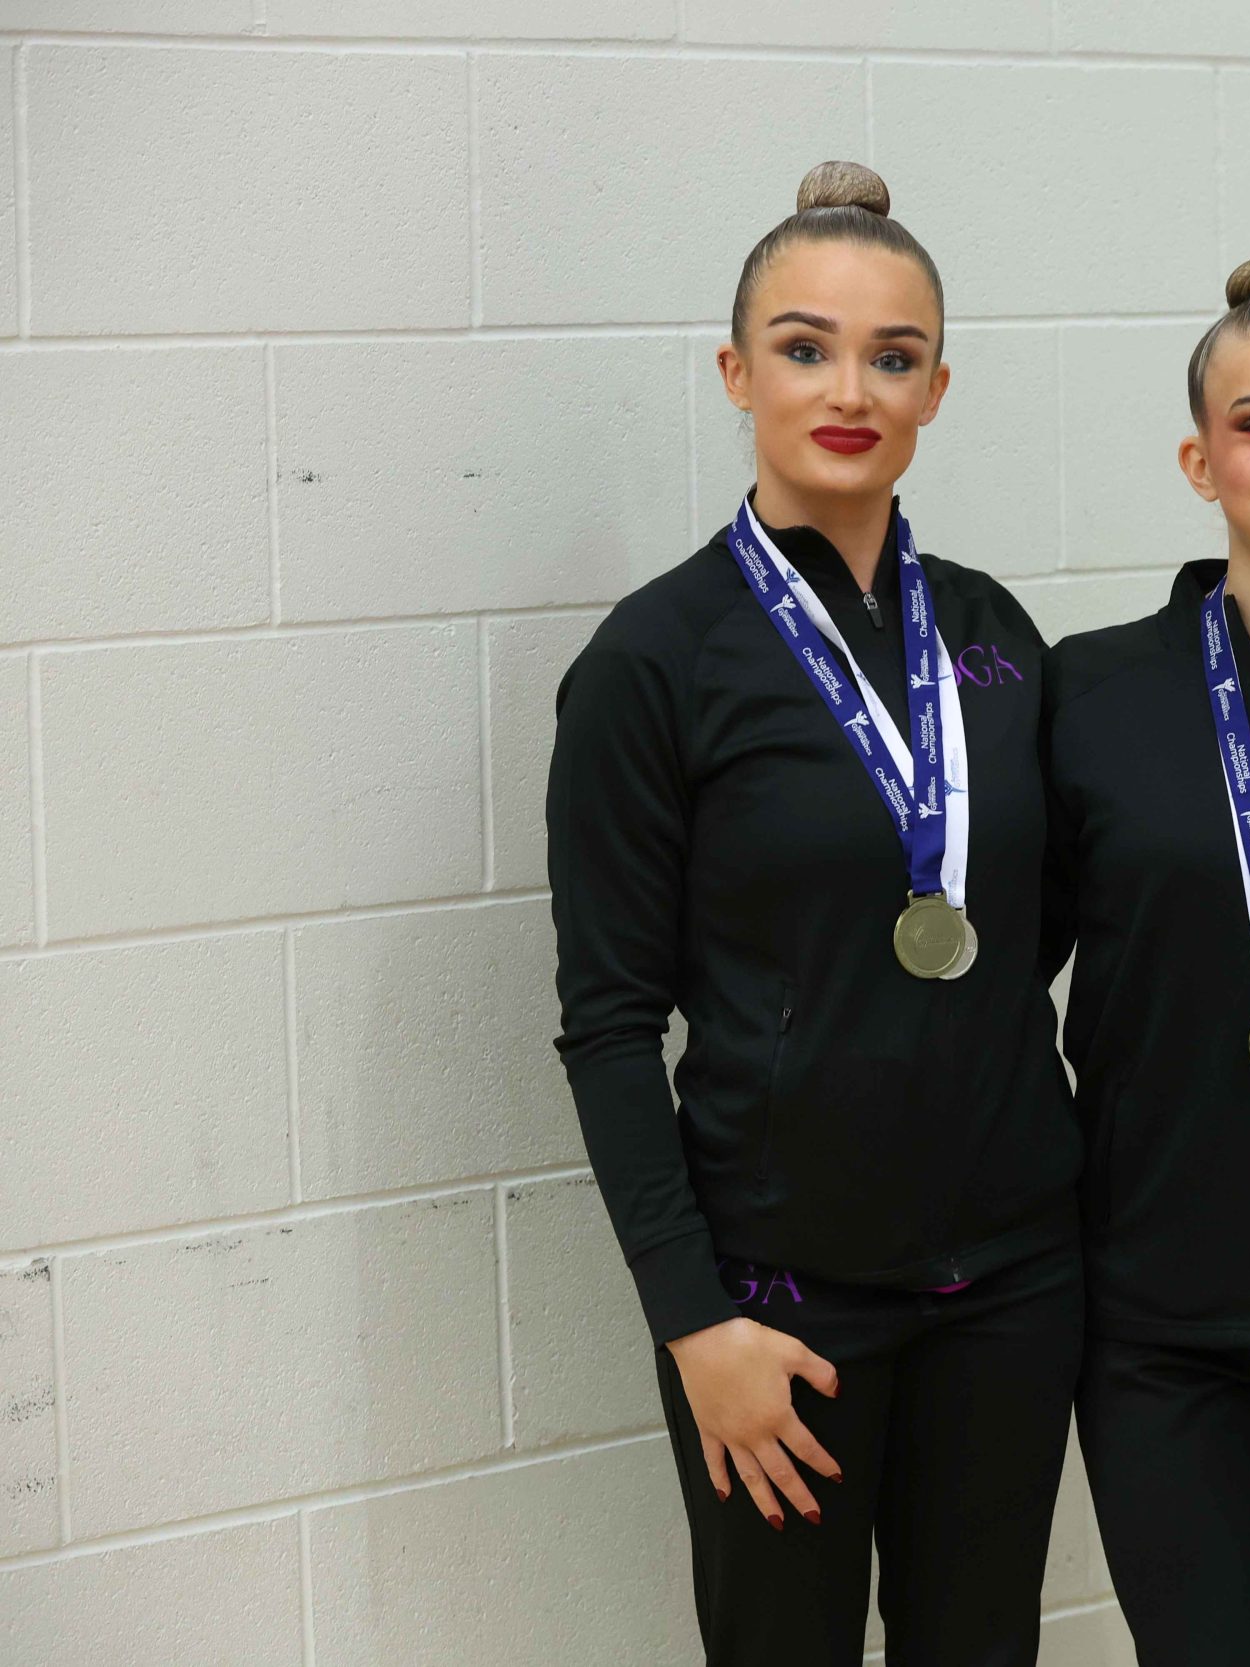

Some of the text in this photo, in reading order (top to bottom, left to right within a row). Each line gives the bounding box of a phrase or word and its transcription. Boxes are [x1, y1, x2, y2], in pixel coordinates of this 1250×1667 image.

[735, 538, 769, 594] Championships
[746, 544, 770, 578] National
[909, 589, 920, 623] National
[916, 579, 928, 638] Championships
[1205, 610, 1218, 671] Championships
[1212, 619, 1224, 654] National
[802, 647, 843, 706] Championships
[817, 656, 843, 690] National
[952, 645, 1024, 688] GA
[918, 714, 929, 749] National
[926, 702, 937, 764] Championships
[1226, 732, 1247, 794] Championships
[875, 767, 909, 832] Championships
[888, 778, 912, 815] National
